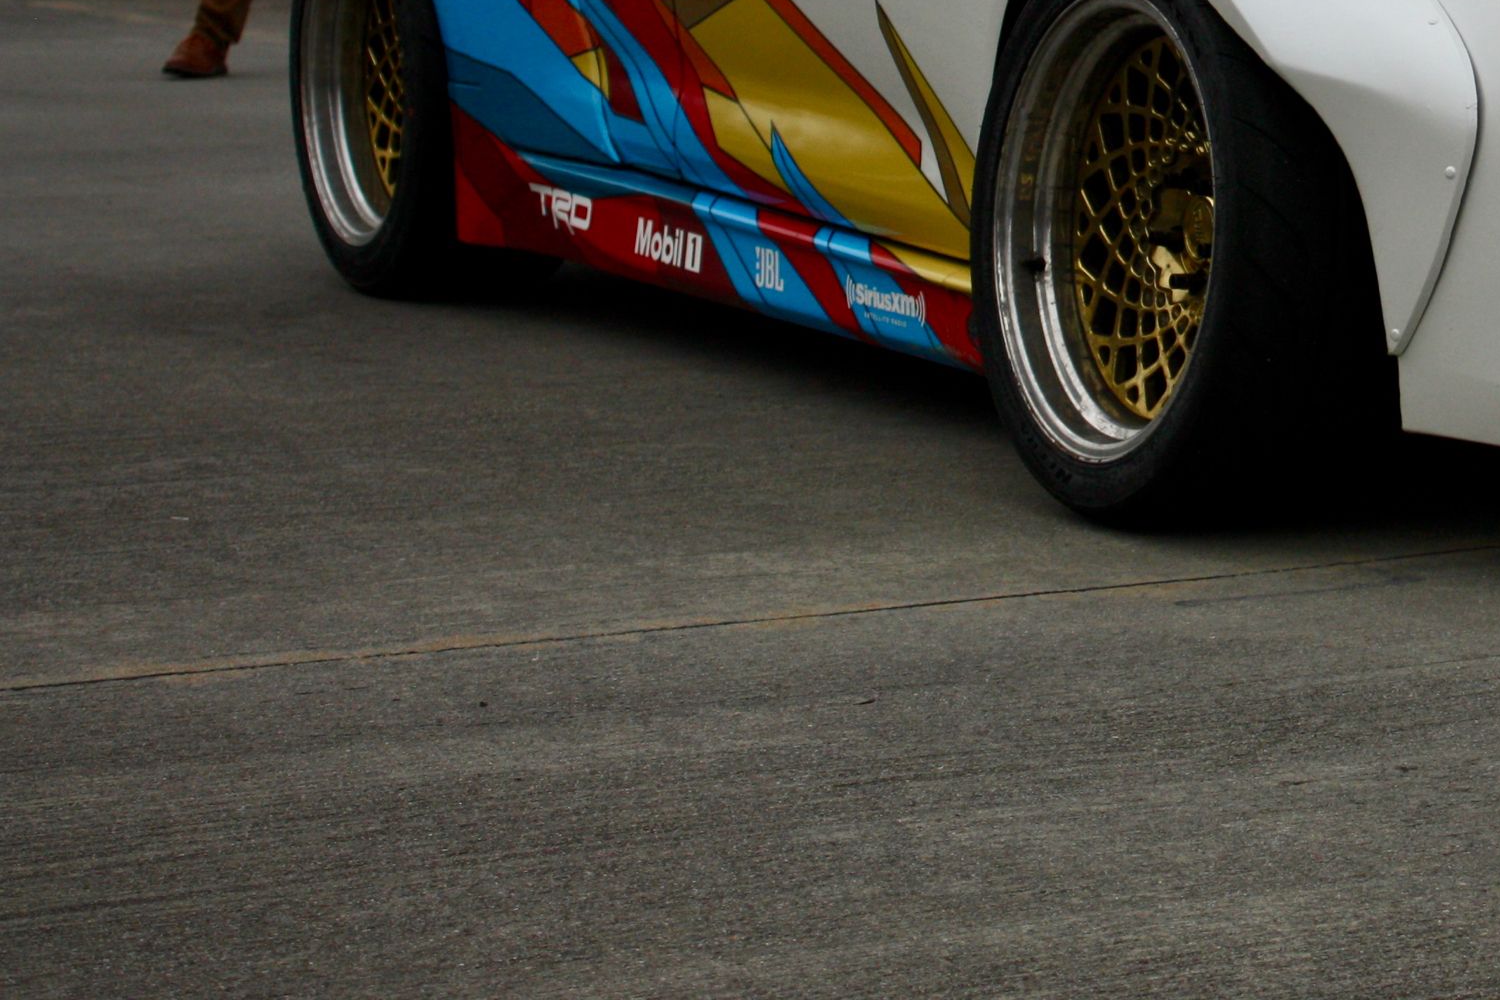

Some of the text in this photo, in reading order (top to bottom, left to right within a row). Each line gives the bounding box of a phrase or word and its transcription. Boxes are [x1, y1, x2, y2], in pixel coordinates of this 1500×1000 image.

[528, 182, 593, 235] TRD
[634, 216, 684, 268] Mobil
[755, 246, 784, 292] JBL
